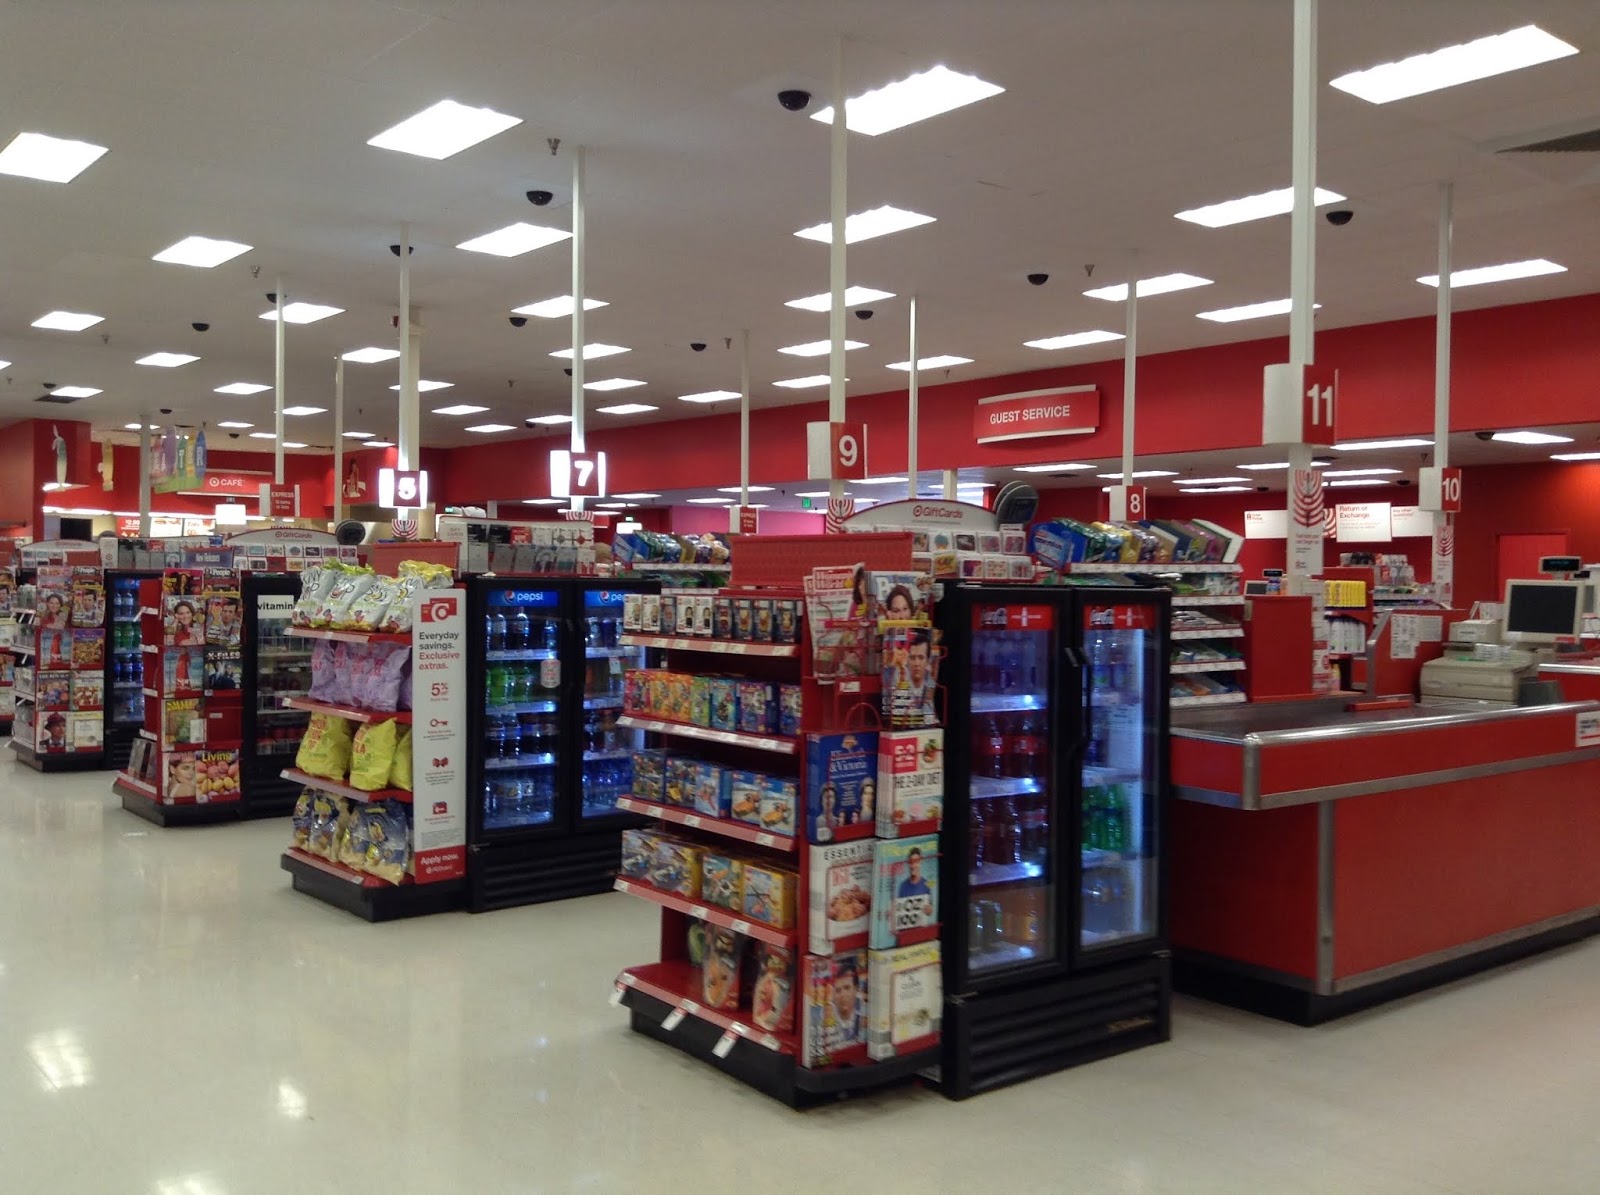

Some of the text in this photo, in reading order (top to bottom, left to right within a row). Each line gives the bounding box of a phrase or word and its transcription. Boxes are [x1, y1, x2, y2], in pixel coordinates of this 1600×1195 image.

[1306, 383, 1334, 427] 11
[989, 405, 1070, 425] GUEST SERVICE
[838, 434, 858, 467] 9
[574, 460, 594, 487] 7
[220, 478, 244, 487] CAFÉ
[397, 477, 418, 499] 5
[1441, 477, 1460, 502] 10
[1129, 493, 1140, 514] 8
[923, 507, 963, 519] GiftCards
[517, 591, 544, 602] pepsi
[258, 602, 293, 610] vitamin
[419, 632, 460, 641] Everyday
[419, 642, 455, 651] savings.
[207, 652, 241, 660] X-FILES
[419, 651, 460, 660] Exclusive
[419, 661, 449, 670] extras.
[202, 752, 232, 762] Living
[420, 854, 442, 866] Apply
